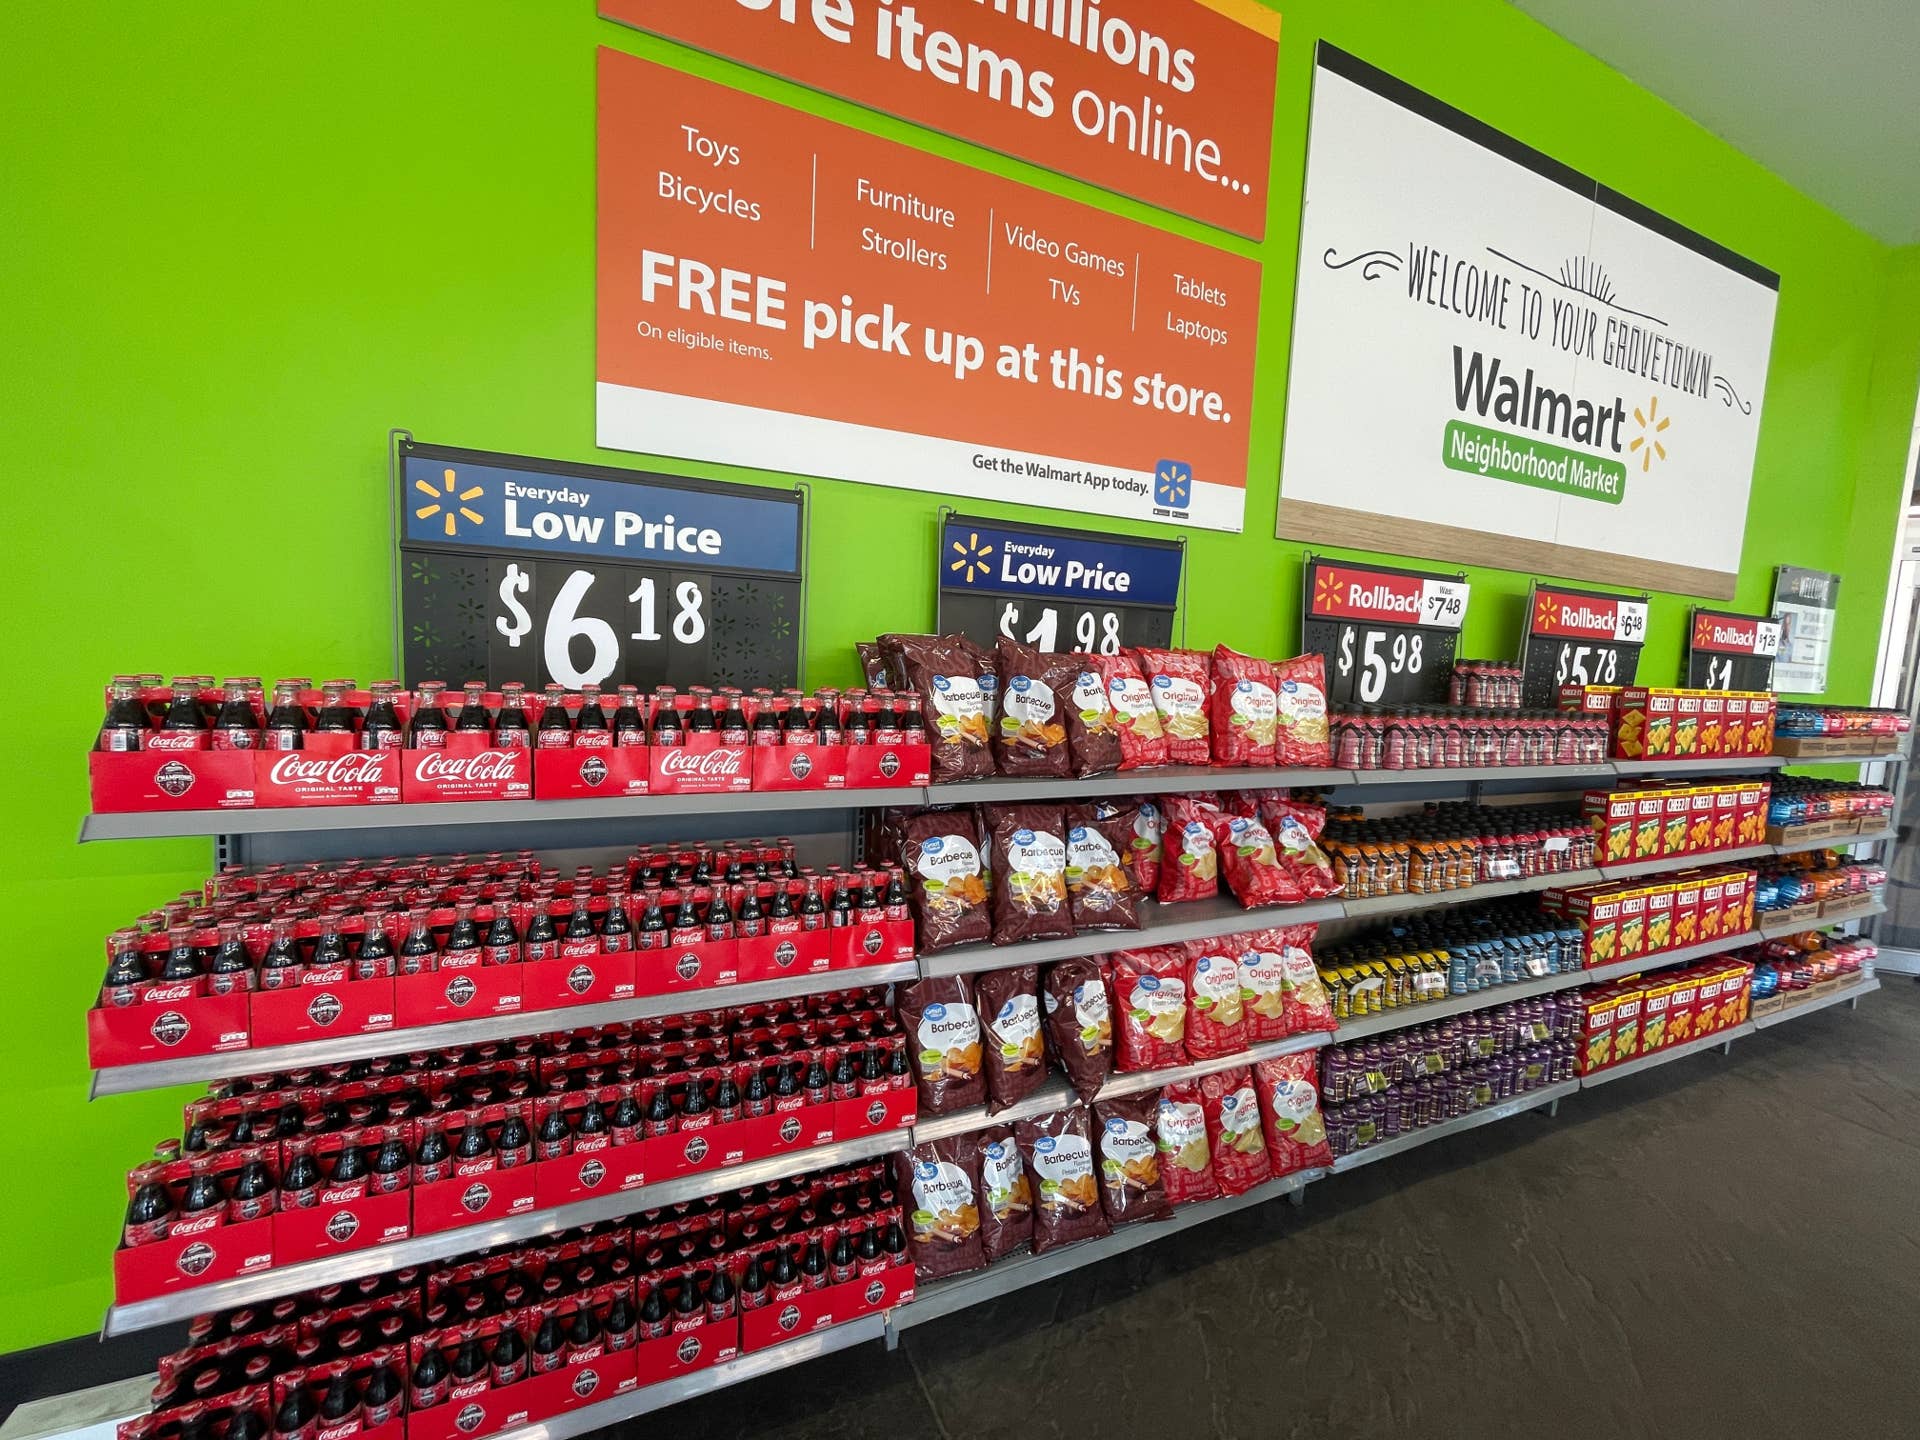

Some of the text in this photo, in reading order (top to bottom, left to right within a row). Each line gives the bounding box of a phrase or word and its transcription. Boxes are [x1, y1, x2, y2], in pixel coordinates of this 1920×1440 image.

[967, 0, 1195, 93] illions
[876, 0, 1251, 196] items online...
[681, 125, 741, 168] Toys
[657, 170, 762, 223] Bicycles
[856, 178, 955, 229] Furniture
[860, 227, 948, 271] Strollers
[1004, 222, 1126, 278] Video Games
[1048, 278, 1081, 307] TVs
[1173, 274, 1228, 308] Tablets
[1166, 311, 1228, 347] Laptops
[1408, 241, 1714, 399] WELCOME TO YOUR GROVETOWN
[637, 320, 774, 361] On eligible items.
[641, 250, 1233, 424] FREE pick up at this store.
[1453, 344, 1626, 453] Walmart
[972, 453, 1149, 497] Get the Walmart App today.
[1451, 429, 1619, 496] Neighborhood Market
[504, 481, 591, 508] Everyday
[504, 500, 722, 555] Low Price
[1004, 541, 1055, 559] Everyday
[1001, 554, 1130, 592] Low Price
[1348, 584, 1422, 614] Rollback
[1561, 606, 1616, 631] Rollback
[1713, 626, 1754, 647] Rollback
[148, 735, 197, 749] Coca-Cola
[575, 734, 610, 746] Coca-Cola
[787, 733, 815, 745] Coca-Cola
[876, 733, 903, 745] Coca-Cola
[270, 752, 390, 785] Coca-Cola
[415, 751, 522, 781] Coca-Cola
[660, 748, 744, 775] Coca-Cola
[930, 851, 973, 867] Barbecue
[1020, 847, 1064, 858] Barbecue
[673, 932, 701, 945] Coca-Cola
[771, 921, 799, 933] Coca-Cola
[441, 953, 478, 968] Coca-Cola
[564, 943, 597, 957] Coca-Cola
[302, 969, 343, 984] Coca-Cola
[1205, 971, 1236, 985] Original
[1250, 968, 1282, 980] Origin
[144, 986, 190, 1002] Coca-Cola
[575, 1138, 608, 1152] Coca-Cola
[458, 1160, 494, 1176] Coca-Cola
[321, 1186, 361, 1203] Coca-Cola
[171, 1214, 218, 1236] Coca-Cola
